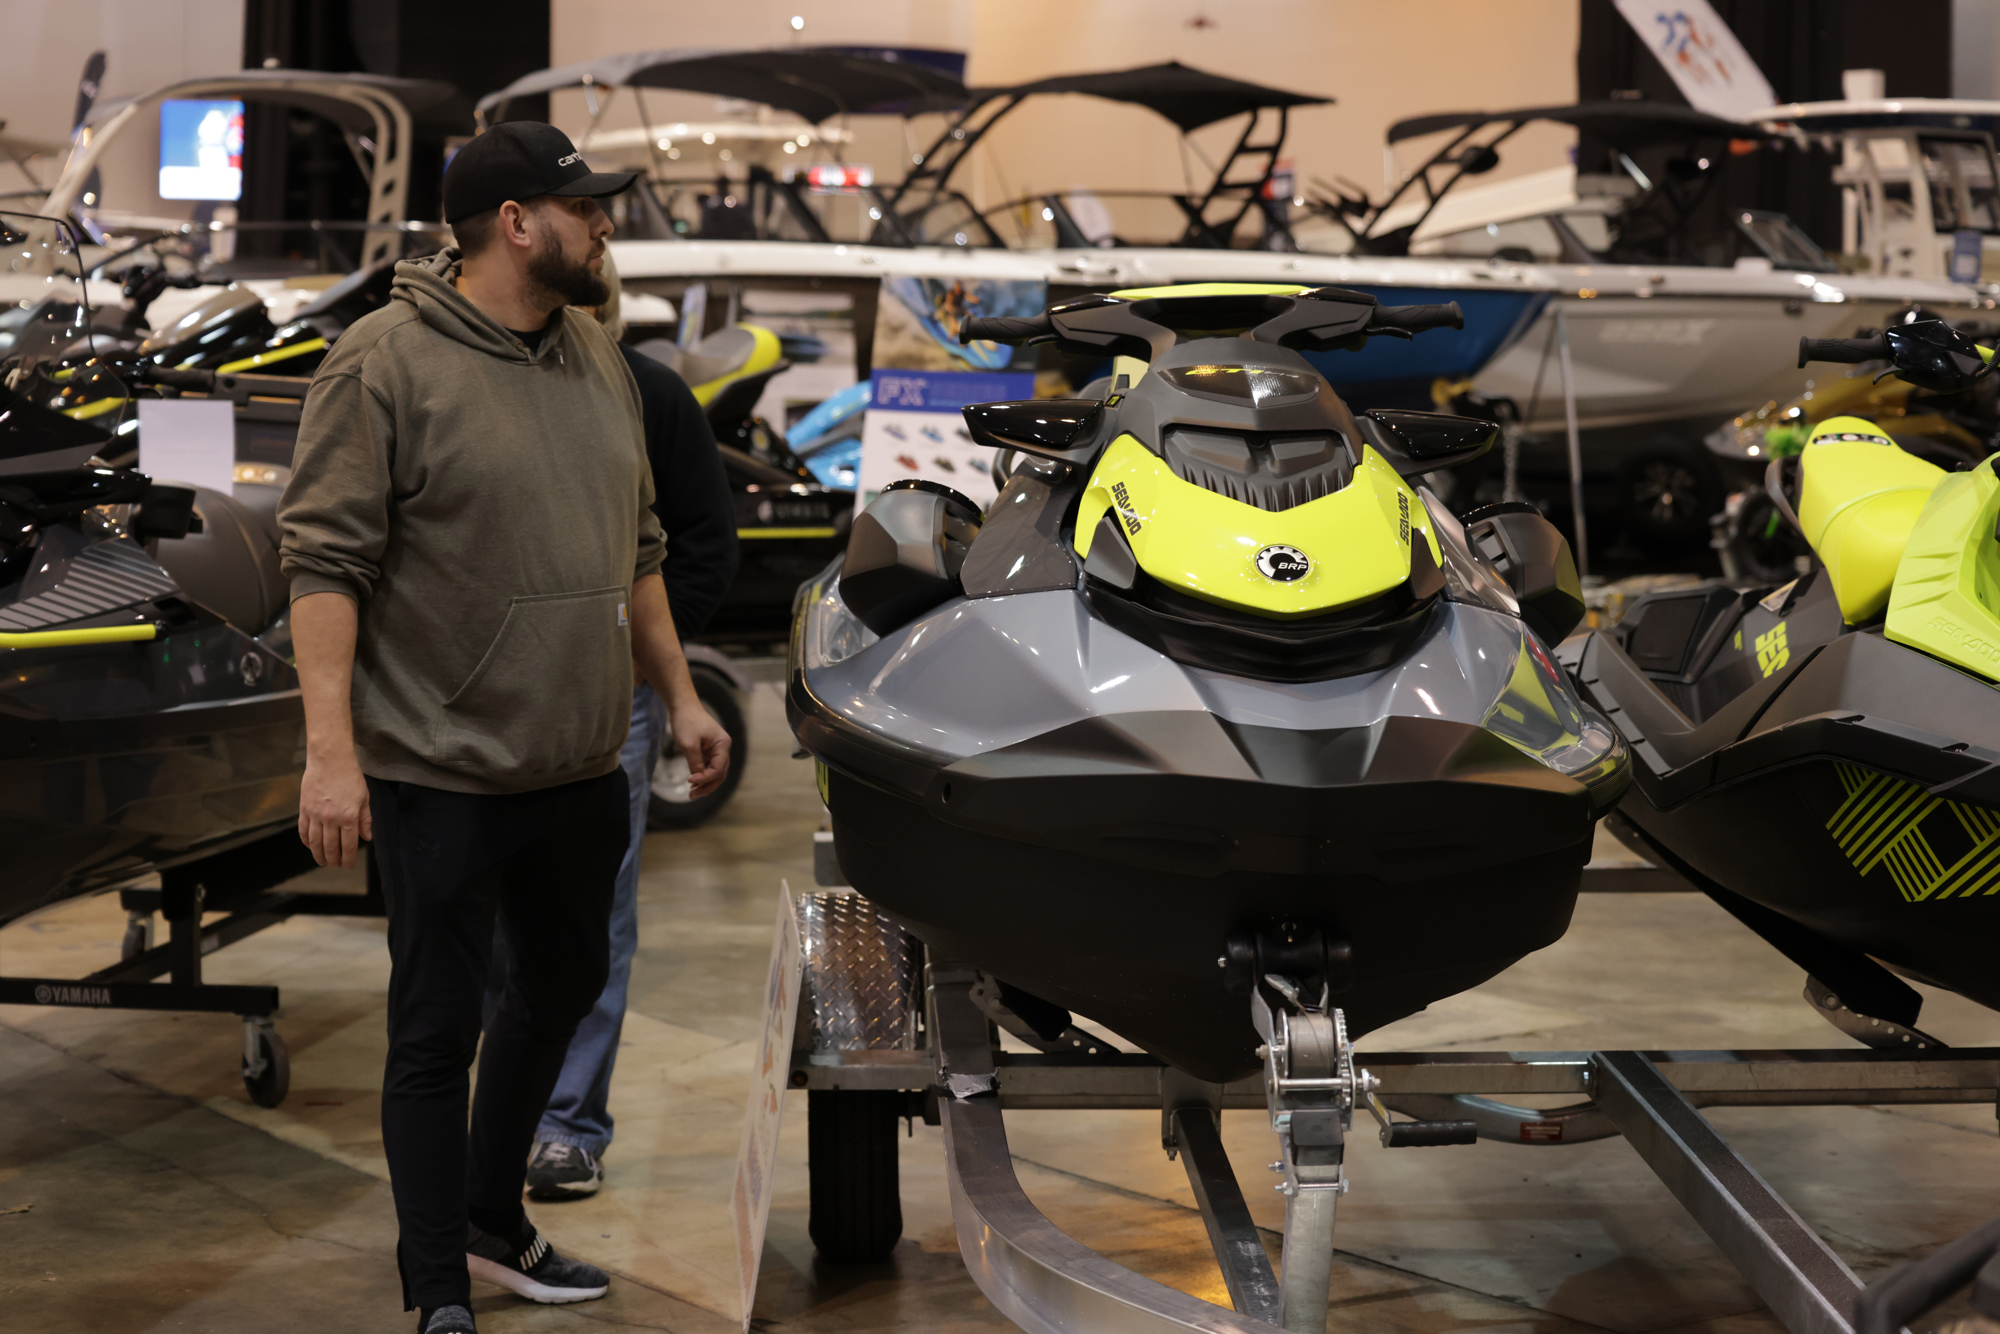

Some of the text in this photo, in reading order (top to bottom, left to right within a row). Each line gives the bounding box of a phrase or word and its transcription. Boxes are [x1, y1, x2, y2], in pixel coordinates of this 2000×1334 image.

[877, 375, 927, 407] FX
[1278, 562, 1307, 571] BRP
[52, 985, 112, 1005] YAMAHA
